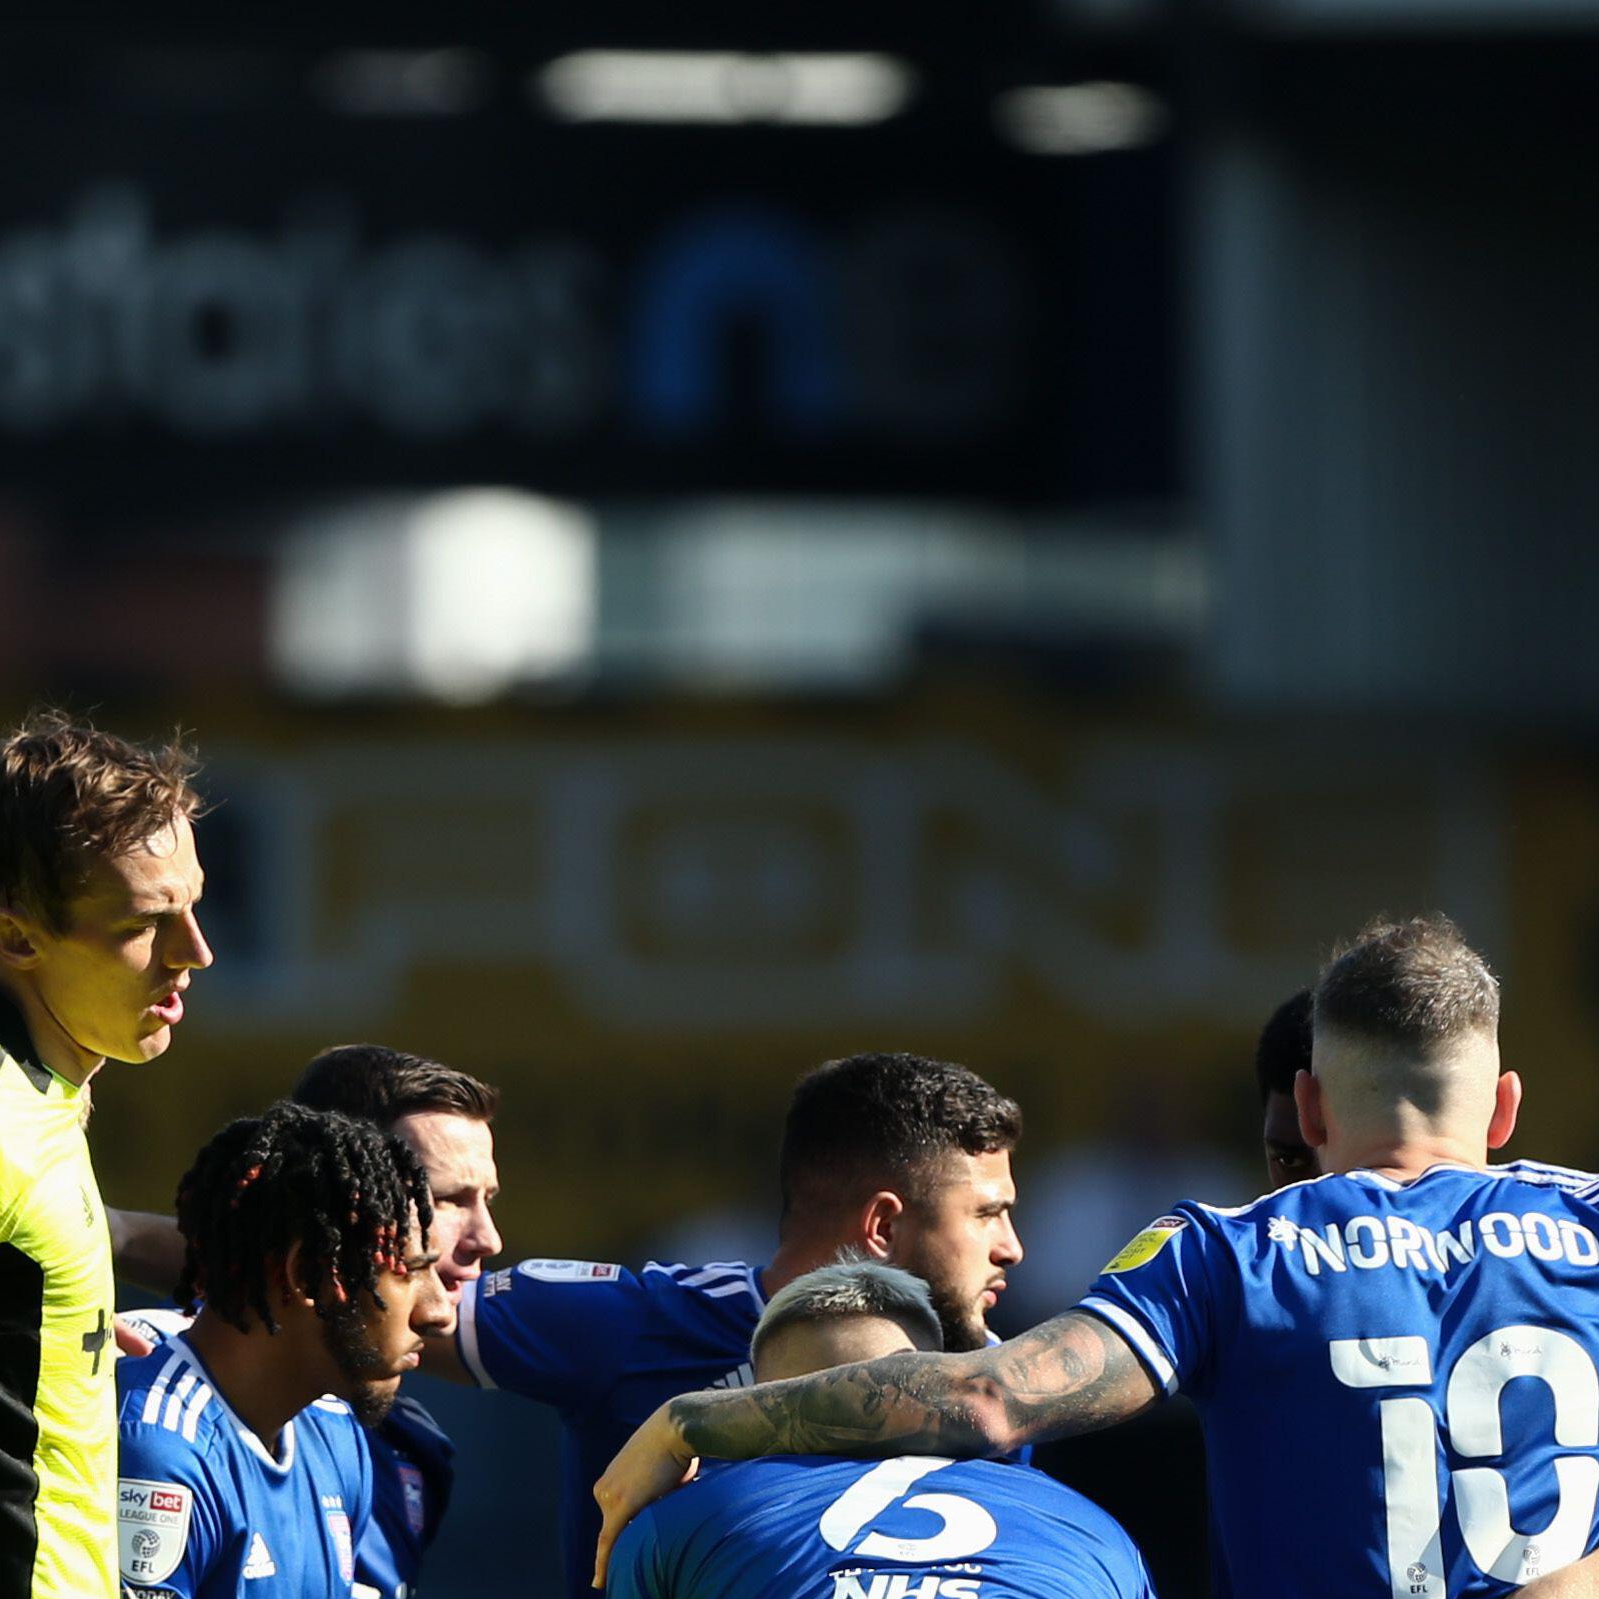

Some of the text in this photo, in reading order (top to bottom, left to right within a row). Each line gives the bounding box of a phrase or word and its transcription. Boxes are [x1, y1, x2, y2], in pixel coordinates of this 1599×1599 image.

[120, 1488, 182, 1510] sky bet
[119, 1508, 157, 1523] LEAGUE
[819, 1455, 998, 1562] 6
[131, 1559, 155, 1574] EFL
[1410, 1584, 1428, 1595] EFL
